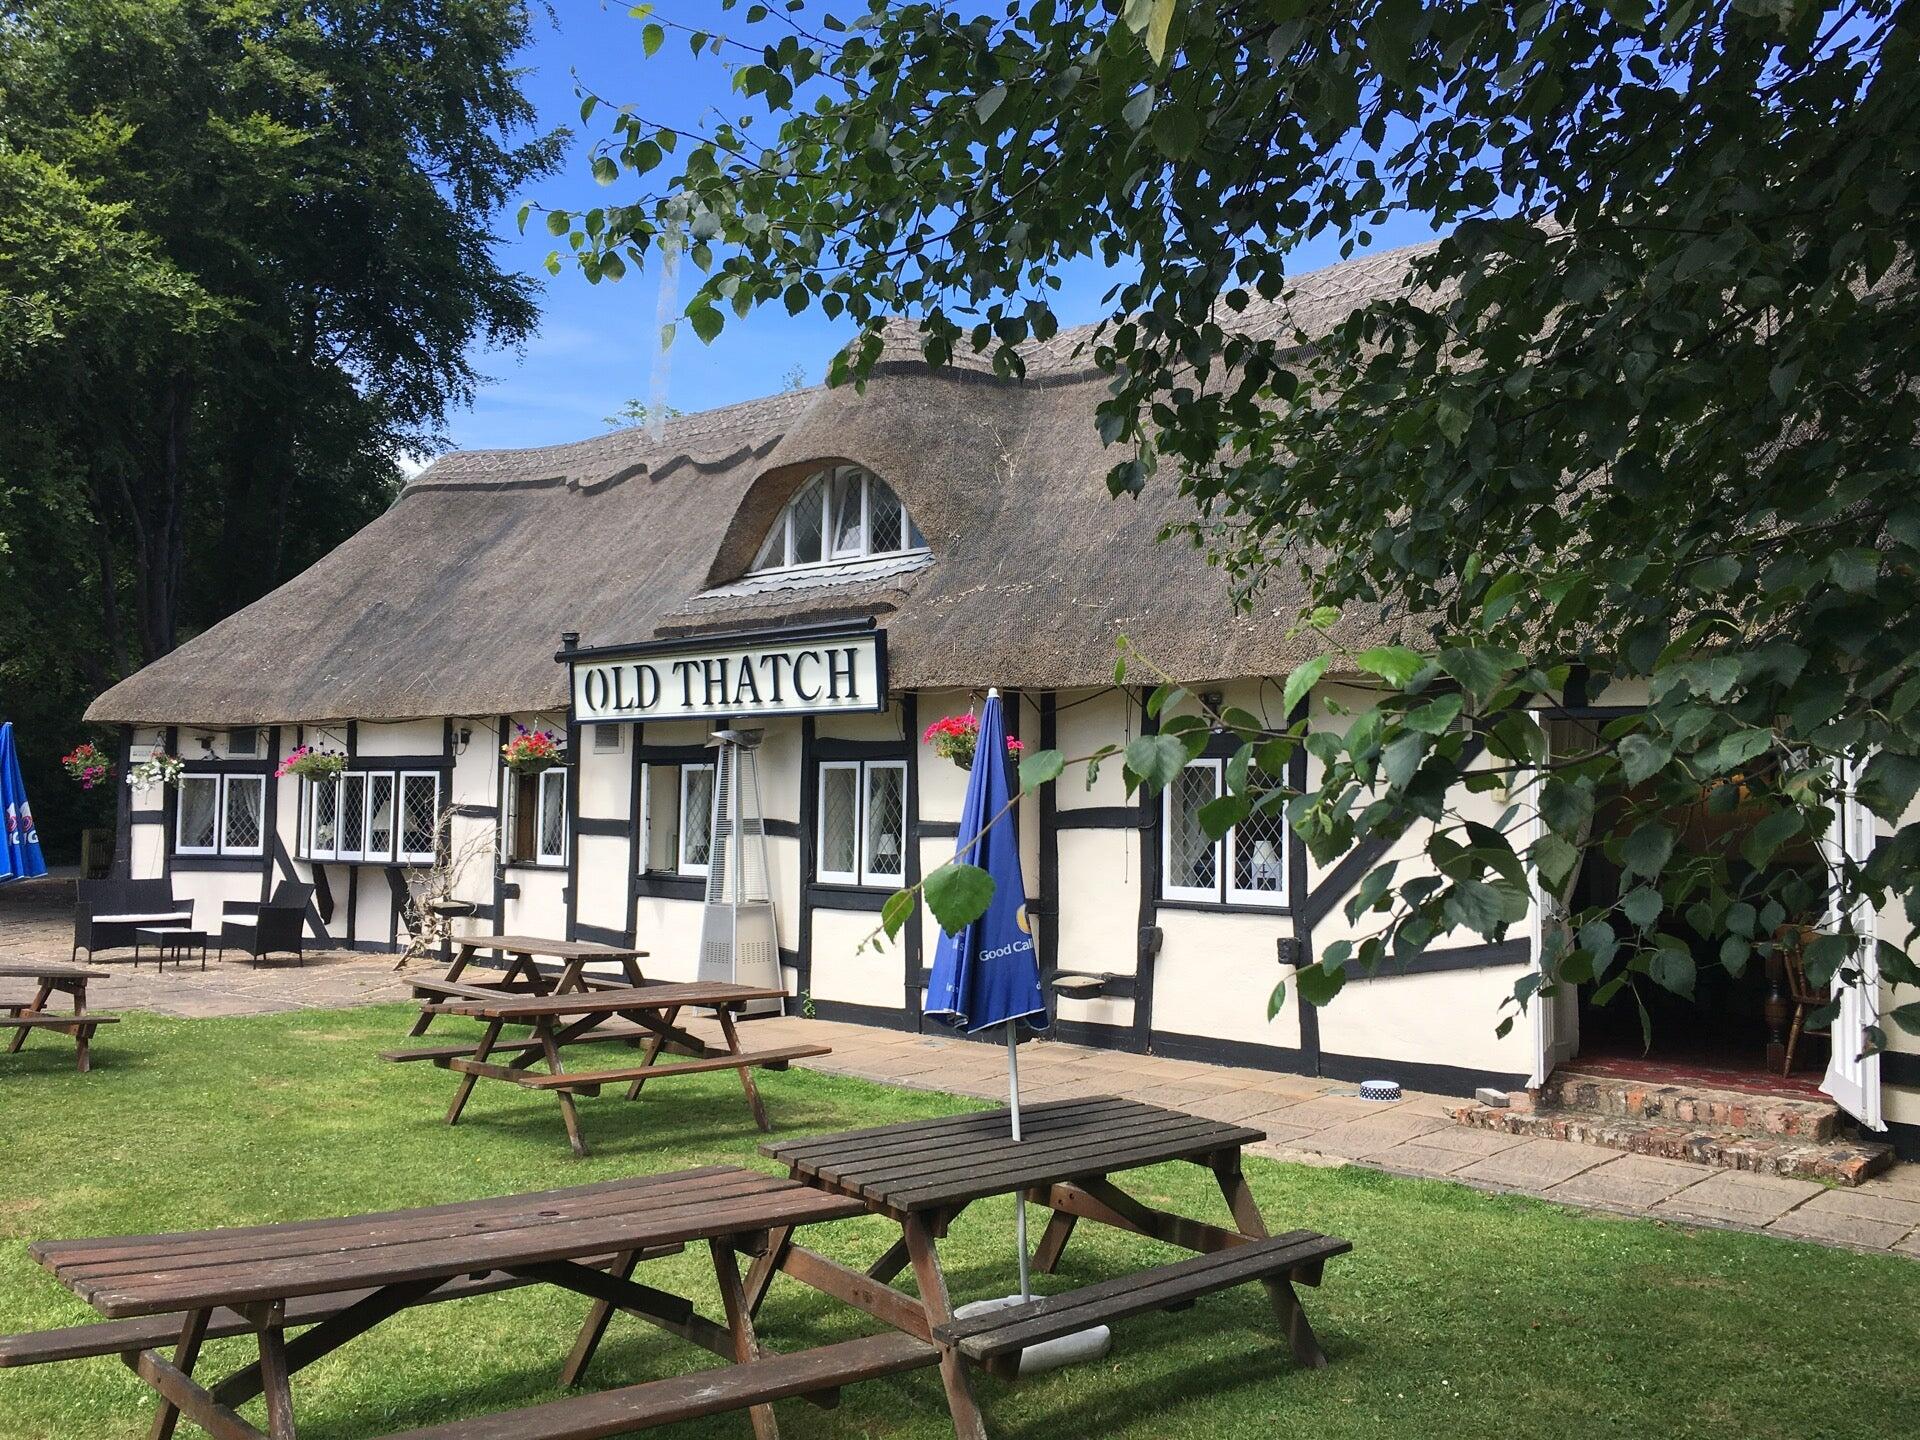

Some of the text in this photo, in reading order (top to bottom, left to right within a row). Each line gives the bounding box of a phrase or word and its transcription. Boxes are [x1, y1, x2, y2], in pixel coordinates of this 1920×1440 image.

[585, 648, 859, 711] OLD THATCH
[979, 943, 1012, 961] Good
